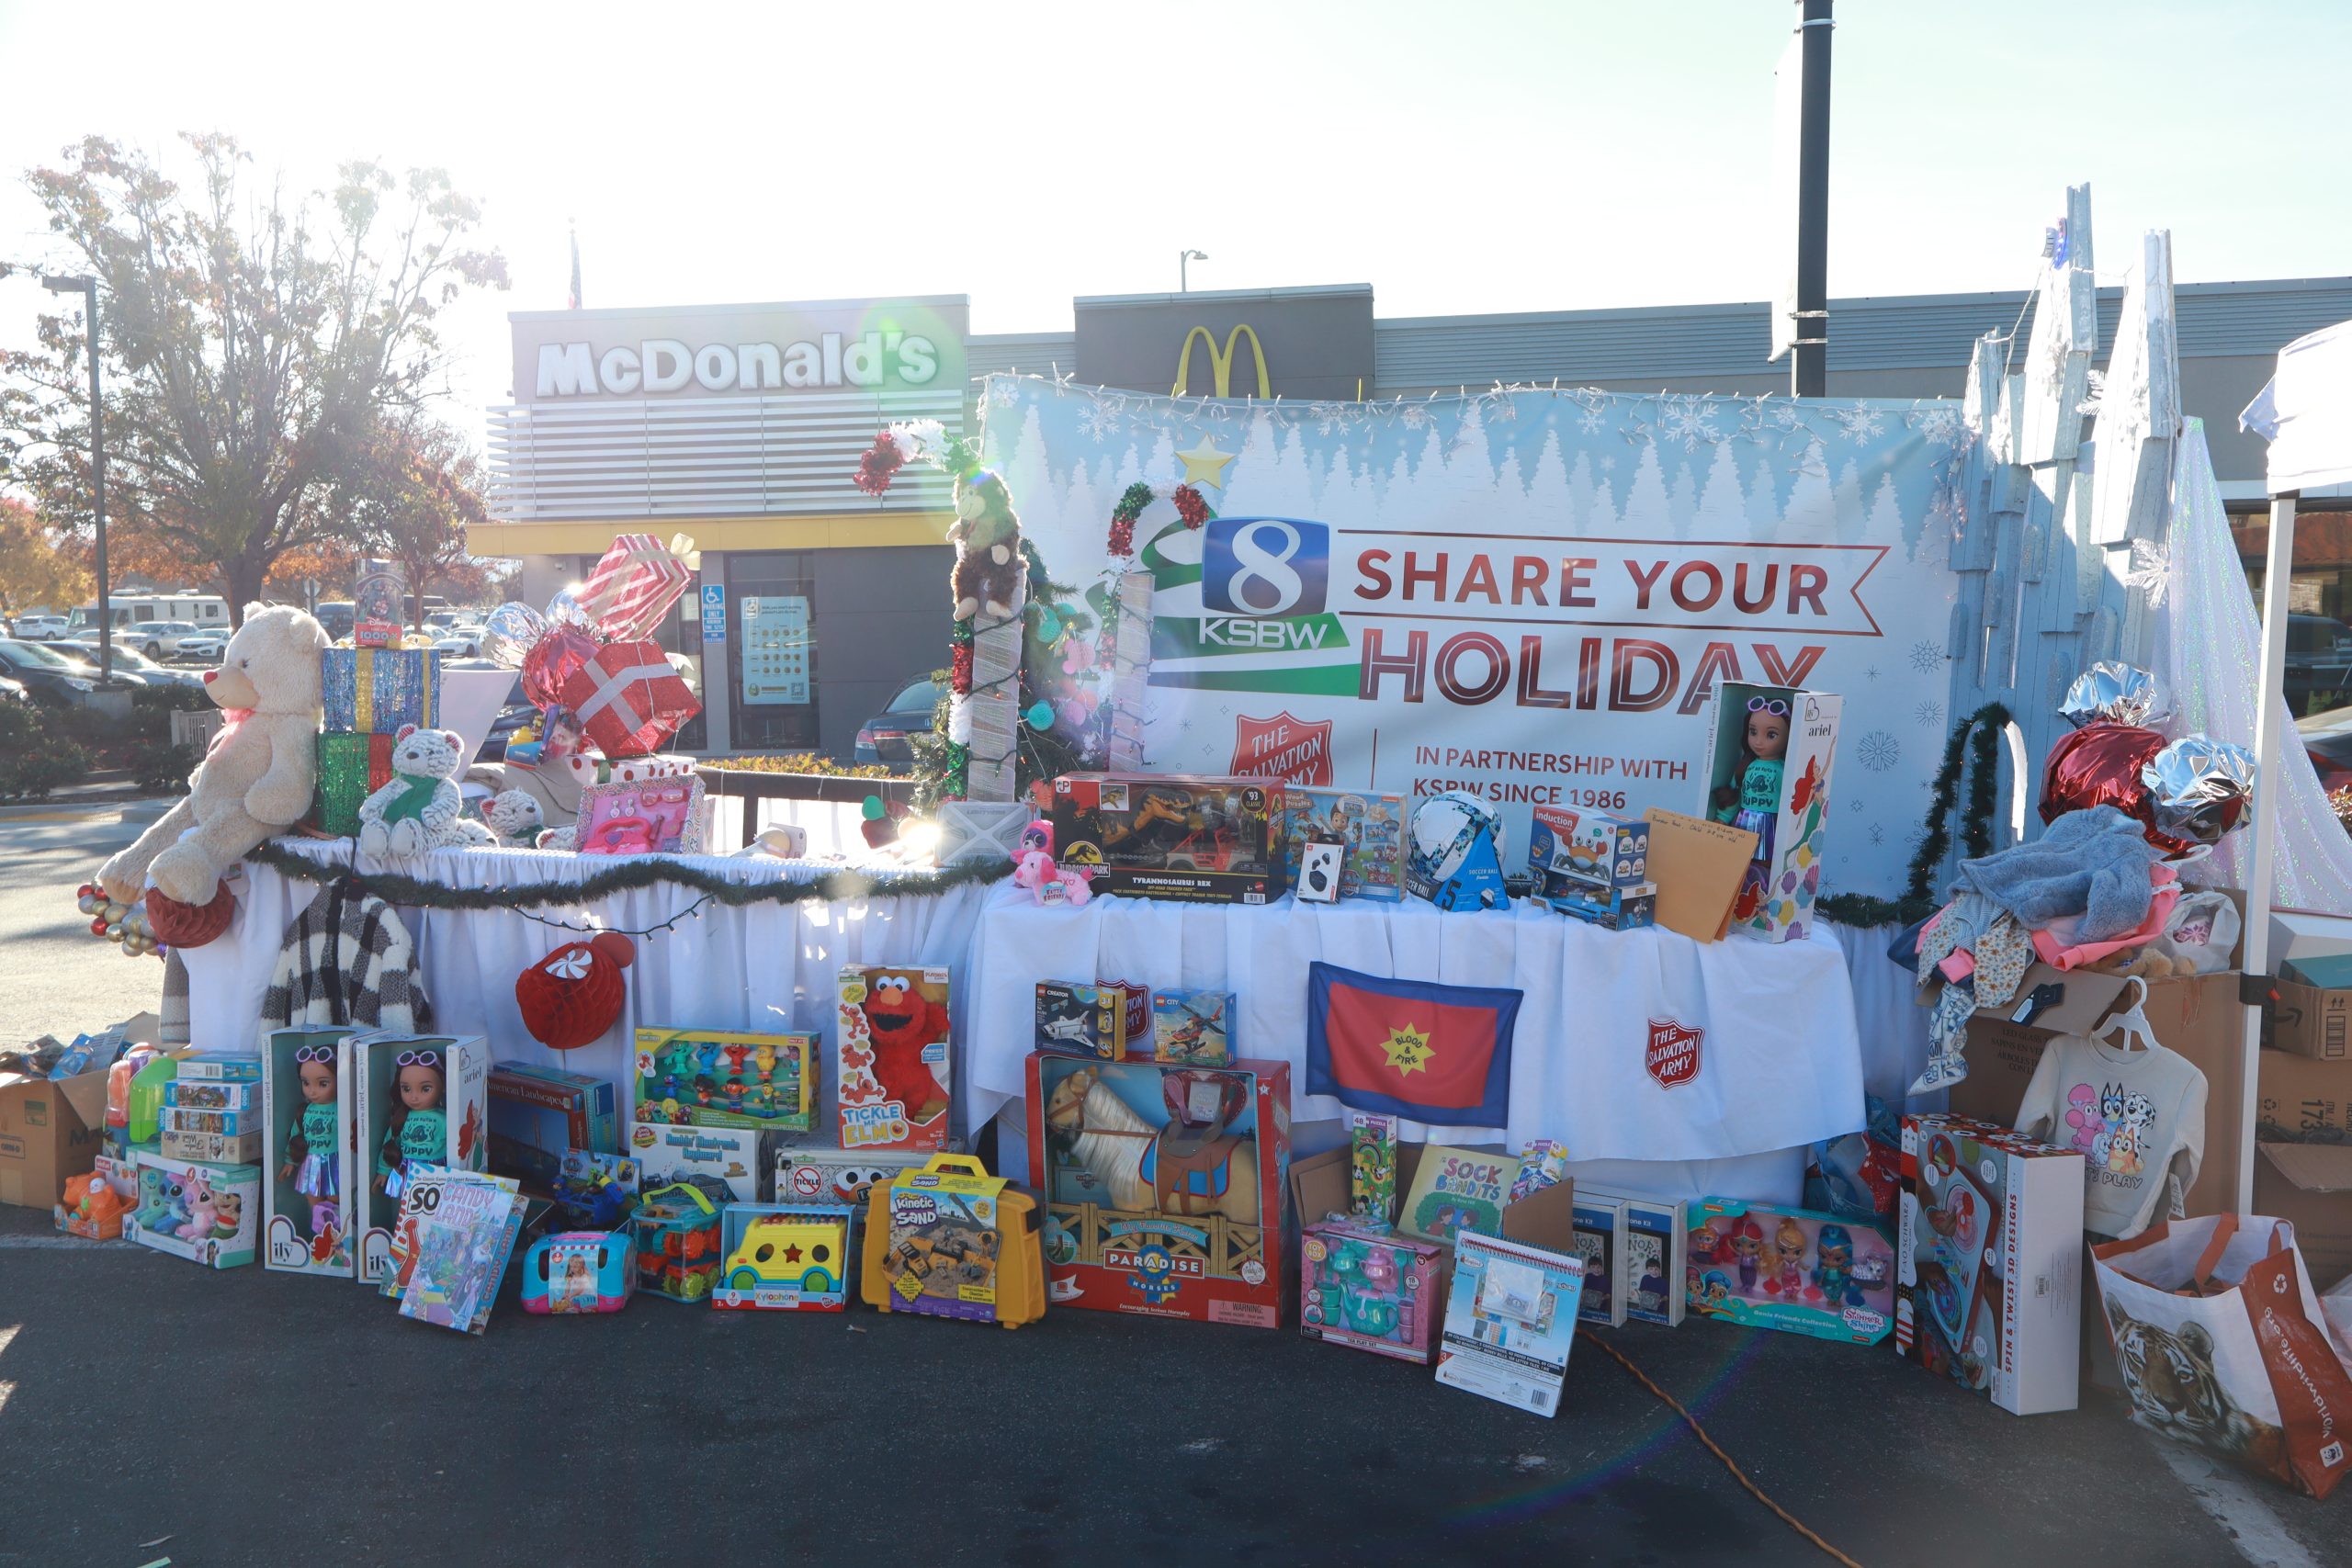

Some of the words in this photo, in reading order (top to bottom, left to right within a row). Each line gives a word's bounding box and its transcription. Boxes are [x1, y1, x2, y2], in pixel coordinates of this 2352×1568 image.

[536, 332, 939, 398] McDonald's
[1227, 520, 1303, 615] 8
[1353, 548, 1597, 607] SHARE
[1623, 559, 1828, 616] YOUR
[1198, 617, 1329, 650] KSBW
[1358, 628, 1827, 715] HOLIDAY
[1251, 724, 1290, 758] THE
[1808, 724, 1831, 737] ariel
[1238, 732, 1322, 776] ALVATION
[1416, 746, 1440, 765] IN
[1446, 748, 1614, 776] PARTNERSHIP
[1620, 758, 1688, 780] WITH
[1488, 784, 1563, 805] SINCE
[1569, 788, 1626, 809] 1986
[1536, 810, 1573, 827] induction
[1089, 864, 1108, 874] PARK
[1132, 877, 1195, 886] TYRANNOSAURUS
[1442, 878, 1462, 911] 5
[1396, 1036, 1422, 1048] BLOOD
[1655, 1028, 1677, 1046] THE
[1396, 1055, 1419, 1065] FIRE
[1649, 1034, 1696, 1066] SALVATION
[464, 1067, 481, 1084] ariel
[1658, 1053, 1692, 1077] ARMY
[521, 1087, 563, 1106] Landscapes
[843, 1106, 899, 1122] TICKLE
[845, 1121, 907, 1145] ELMO
[308, 1140, 331, 1148] UPPY
[1444, 1157, 1502, 1185] SOCK
[2086, 1168, 2099, 1182] T'S
[2102, 1172, 2143, 1189] PLAY
[441, 1183, 497, 1209] CANDY
[1435, 1174, 1501, 1201] BANDITS
[434, 1202, 476, 1226] LAND
[896, 1198, 933, 1209] Kinetic
[1139, 1222, 1171, 1231] Favorite
[1902, 1201, 1910, 1249] SCHWARZ
[2007, 1193, 2018, 1255] DESIGNS
[274, 1242, 293, 1262] ily
[1109, 1254, 1199, 1273] PARADISE
[2007, 1259, 2015, 1280] 3D
[1132, 1280, 1176, 1292] HORSES
[755, 1292, 799, 1302] Xylophone
[2006, 1285, 2015, 1322] TWIST
[1119, 1303, 1149, 1312] Encouraging
[1167, 1308, 1191, 1317] Horseplay
[1232, 1302, 1263, 1314] WARNING:
[1754, 1310, 1773, 1318] Genie
[1774, 1314, 1801, 1323] Friends
[1802, 1317, 1837, 1328] Collection
[2006, 1325, 2013, 1337] &
[2265, 1306, 2334, 1439] worldwildlife.org
